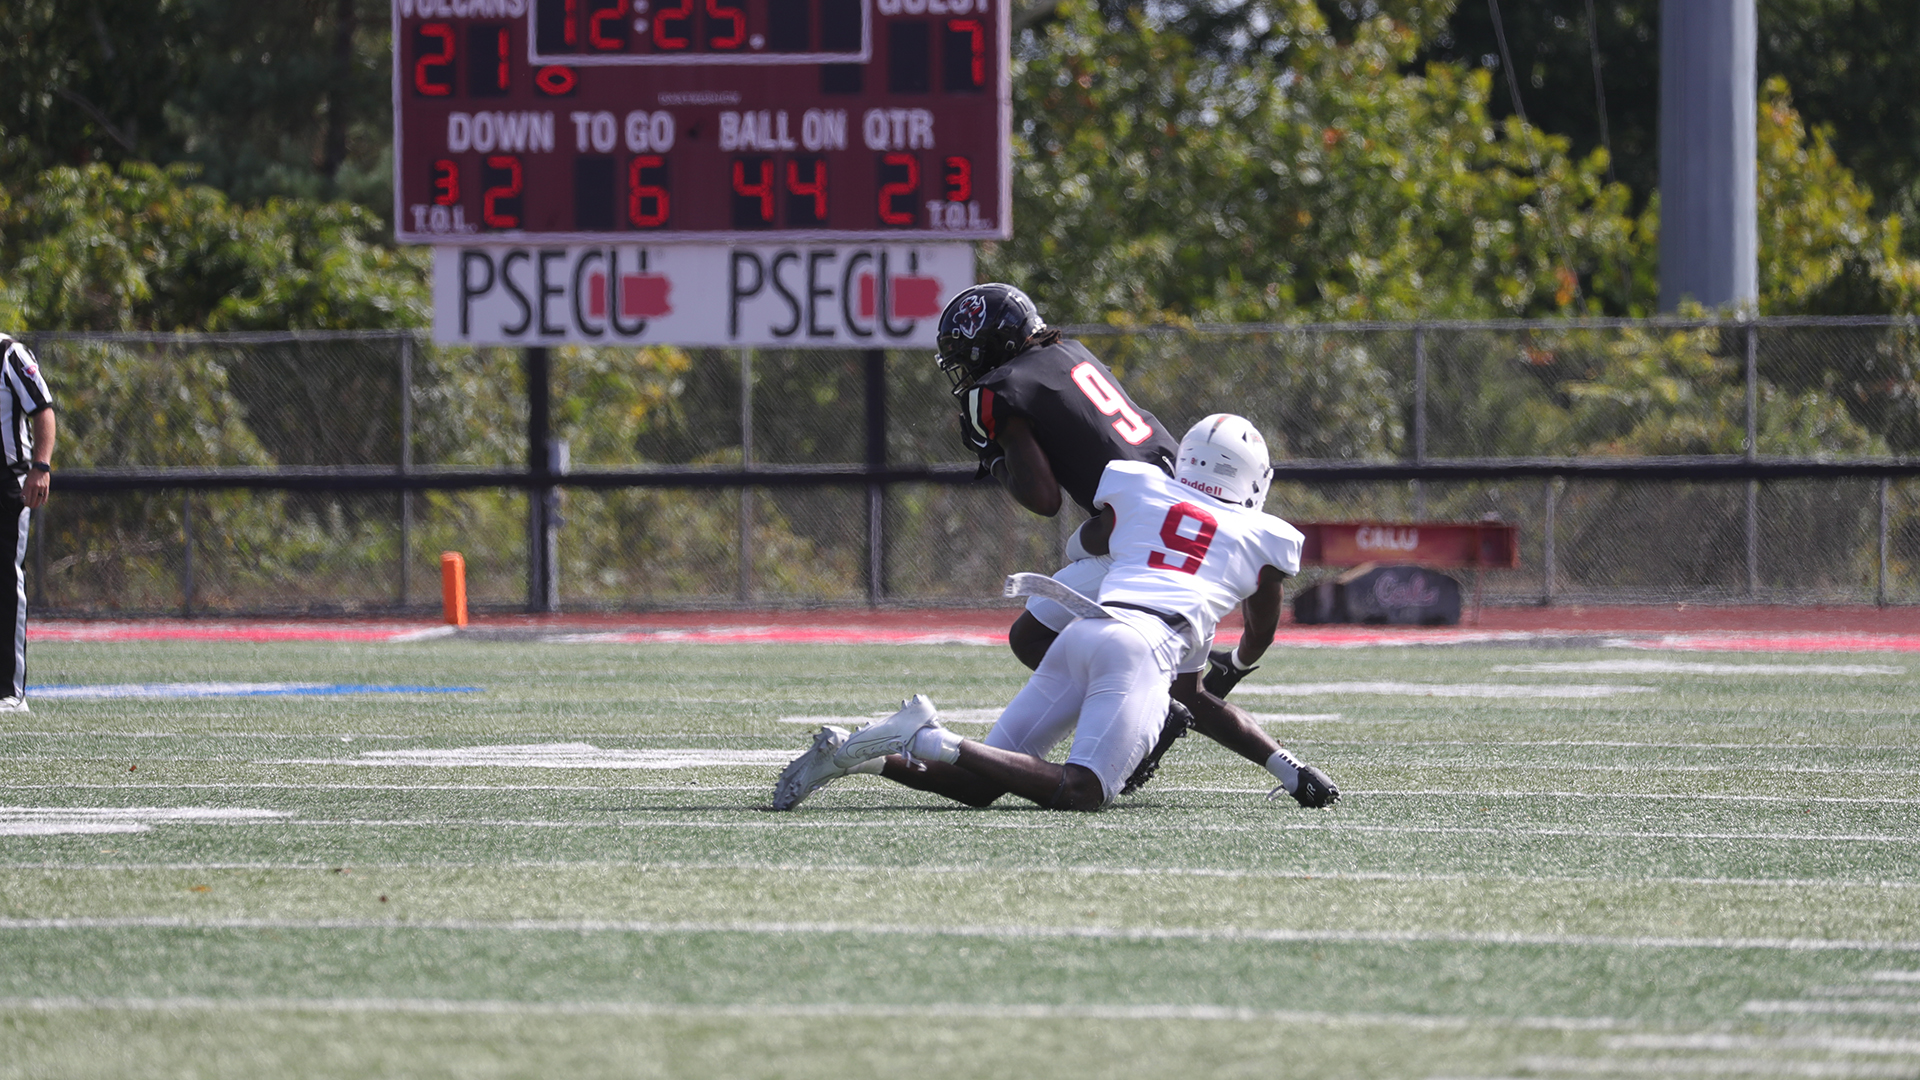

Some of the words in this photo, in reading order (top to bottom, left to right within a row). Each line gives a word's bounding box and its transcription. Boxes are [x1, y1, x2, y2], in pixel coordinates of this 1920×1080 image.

[948, 19, 985, 86] 7
[447, 110, 555, 153] DOWN
[570, 111, 617, 153] TO
[625, 109, 675, 153] GO
[719, 109, 797, 150] BALL
[802, 107, 847, 150] ON
[862, 107, 936, 150] QTR
[433, 159, 459, 206] 3
[483, 155, 523, 228] 2
[628, 155, 669, 227] 6
[732, 159, 828, 222] 44
[878, 152, 920, 225] 2
[945, 156, 971, 202] 3
[457, 248, 648, 338] PSECU
[728, 248, 919, 338] PSECU
[1071, 361, 1154, 446] 9
[1147, 501, 1219, 576] 9
